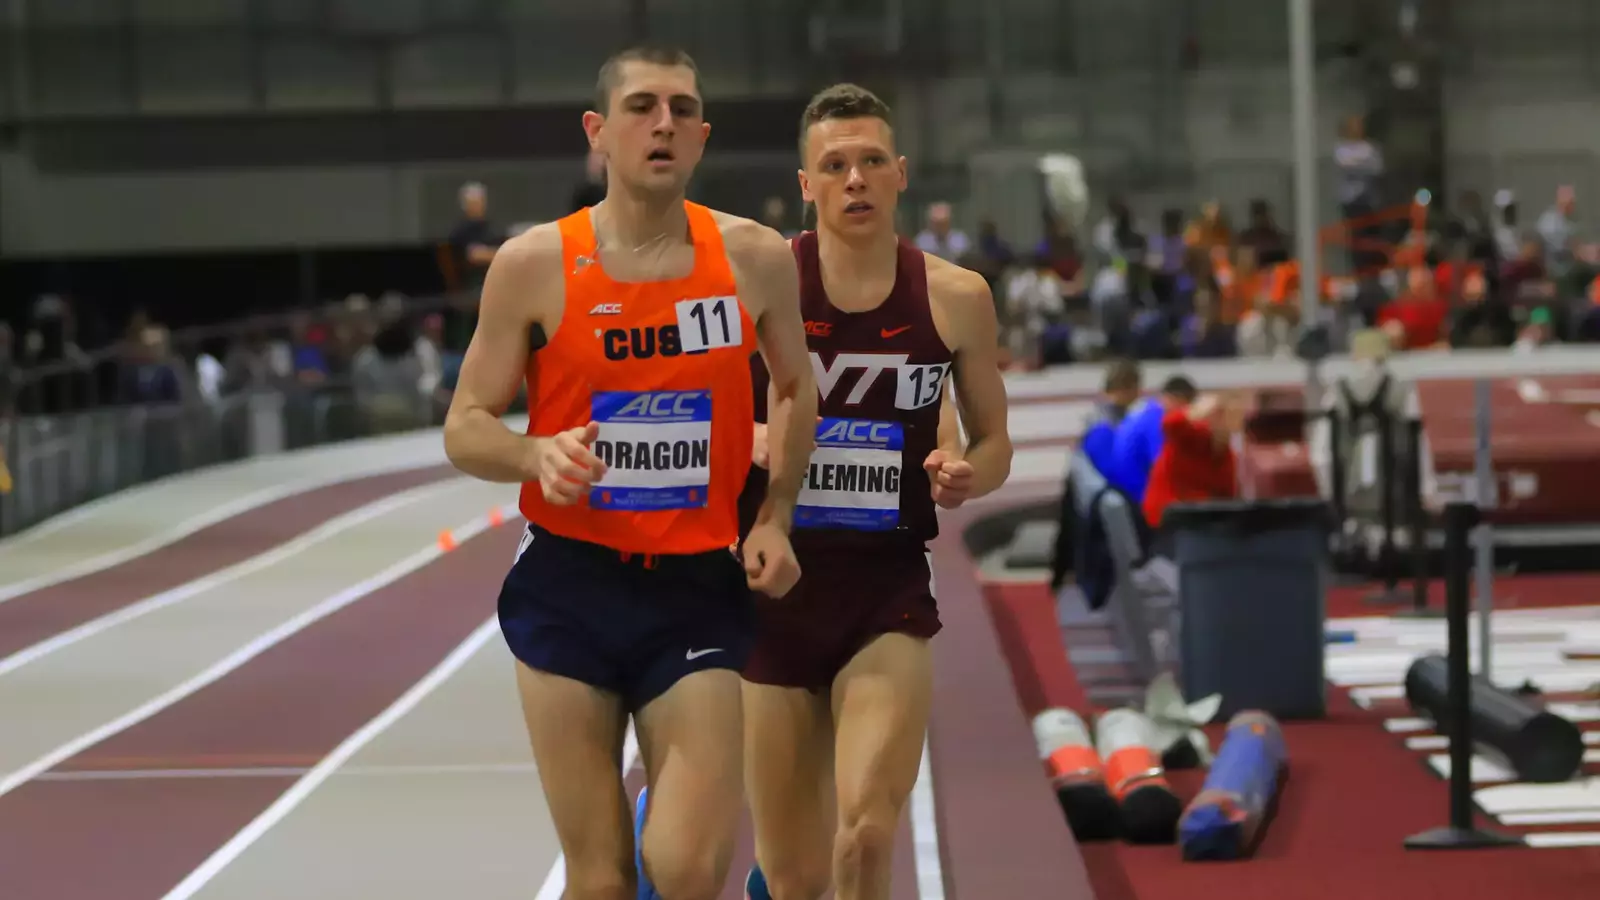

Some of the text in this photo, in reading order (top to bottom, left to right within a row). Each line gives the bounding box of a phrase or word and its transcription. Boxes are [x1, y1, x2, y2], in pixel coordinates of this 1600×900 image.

[589, 303, 622, 314] ACC
[690, 300, 730, 345] 11
[594, 324, 709, 361] 'CUS
[808, 352, 910, 405] VT
[909, 366, 943, 406] 13
[616, 392, 702, 416] ACC
[817, 420, 893, 443] ACC
[595, 439, 708, 470] DRAGON
[800, 463, 899, 493] LEMING
